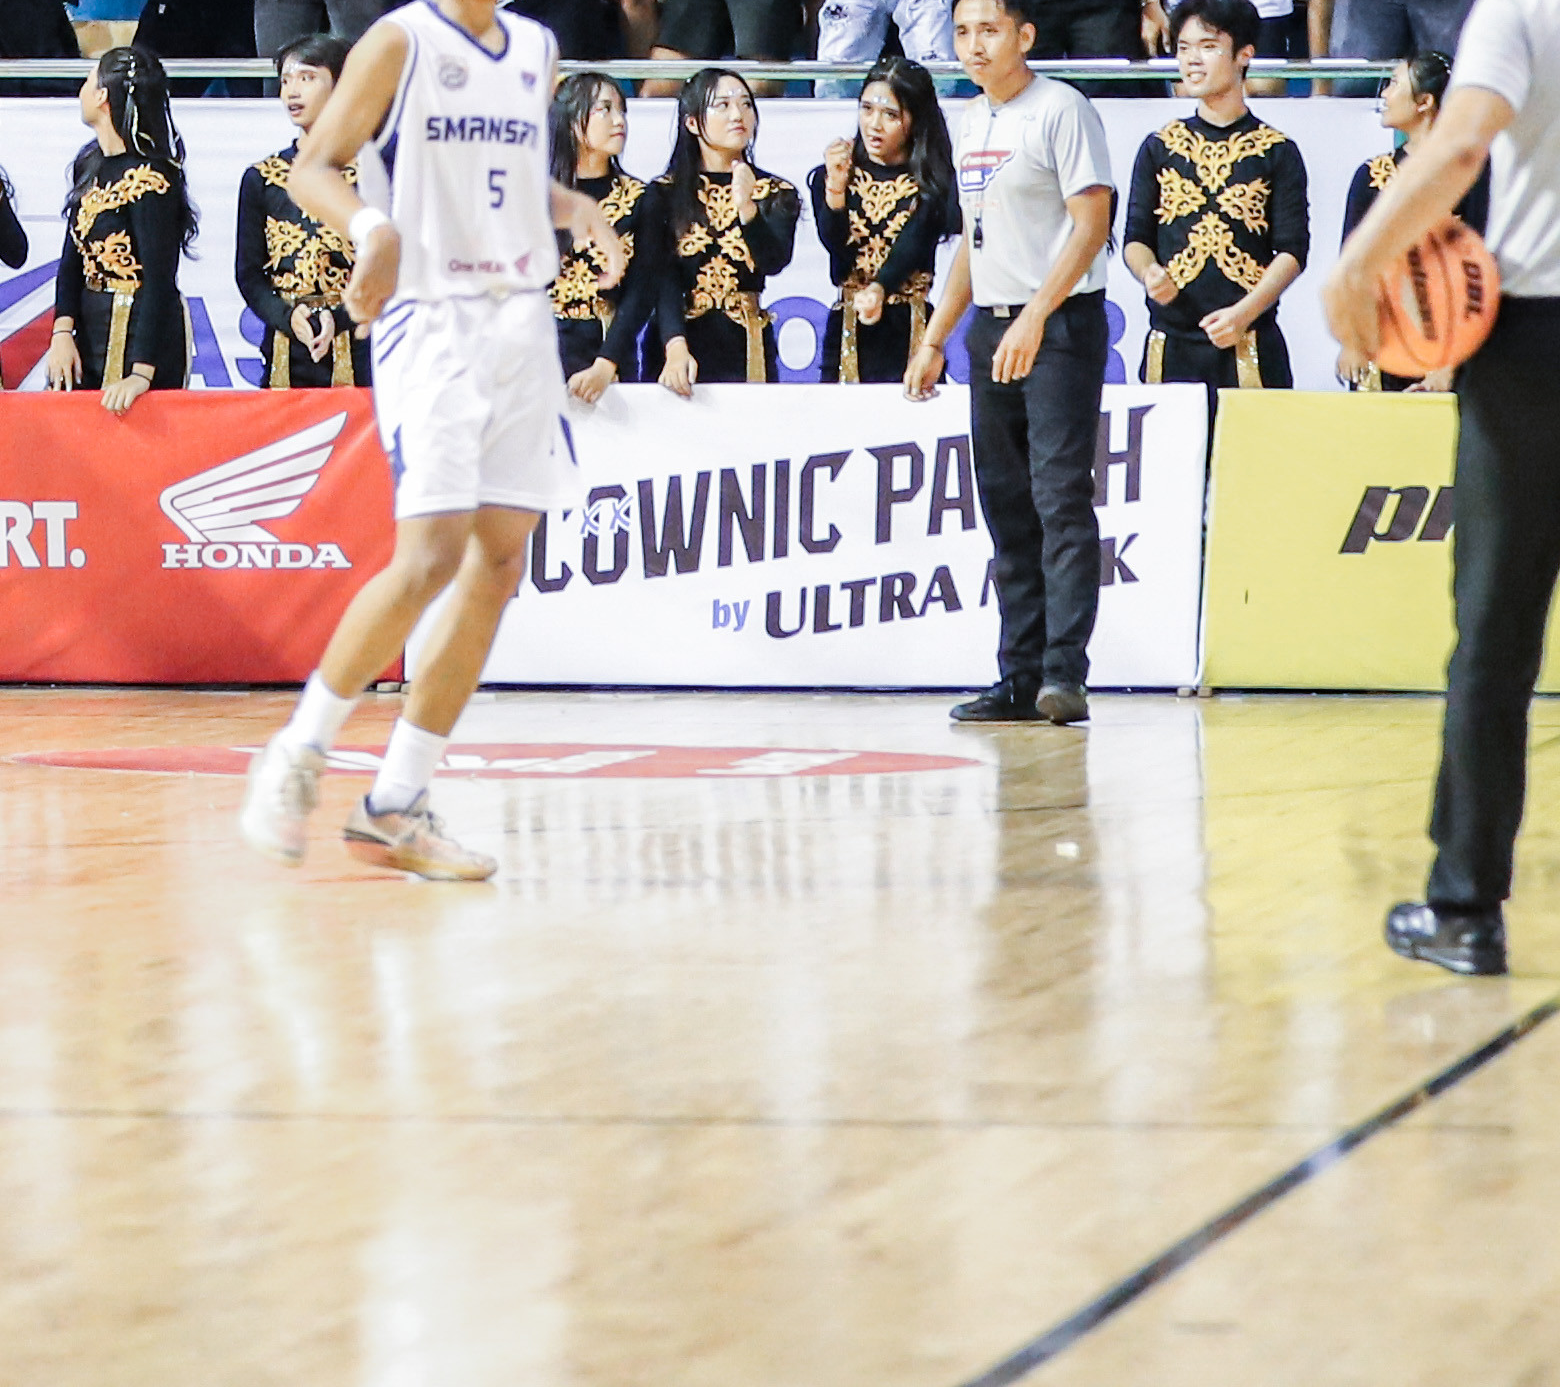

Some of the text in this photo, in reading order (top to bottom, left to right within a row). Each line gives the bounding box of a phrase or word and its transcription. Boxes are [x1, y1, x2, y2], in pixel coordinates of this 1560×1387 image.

[489, 169, 507, 209] 5
[520, 447, 852, 596] COWNIC
[161, 542, 352, 569] HONDA
[712, 598, 750, 631] by
[765, 564, 962, 639] ULTRA
